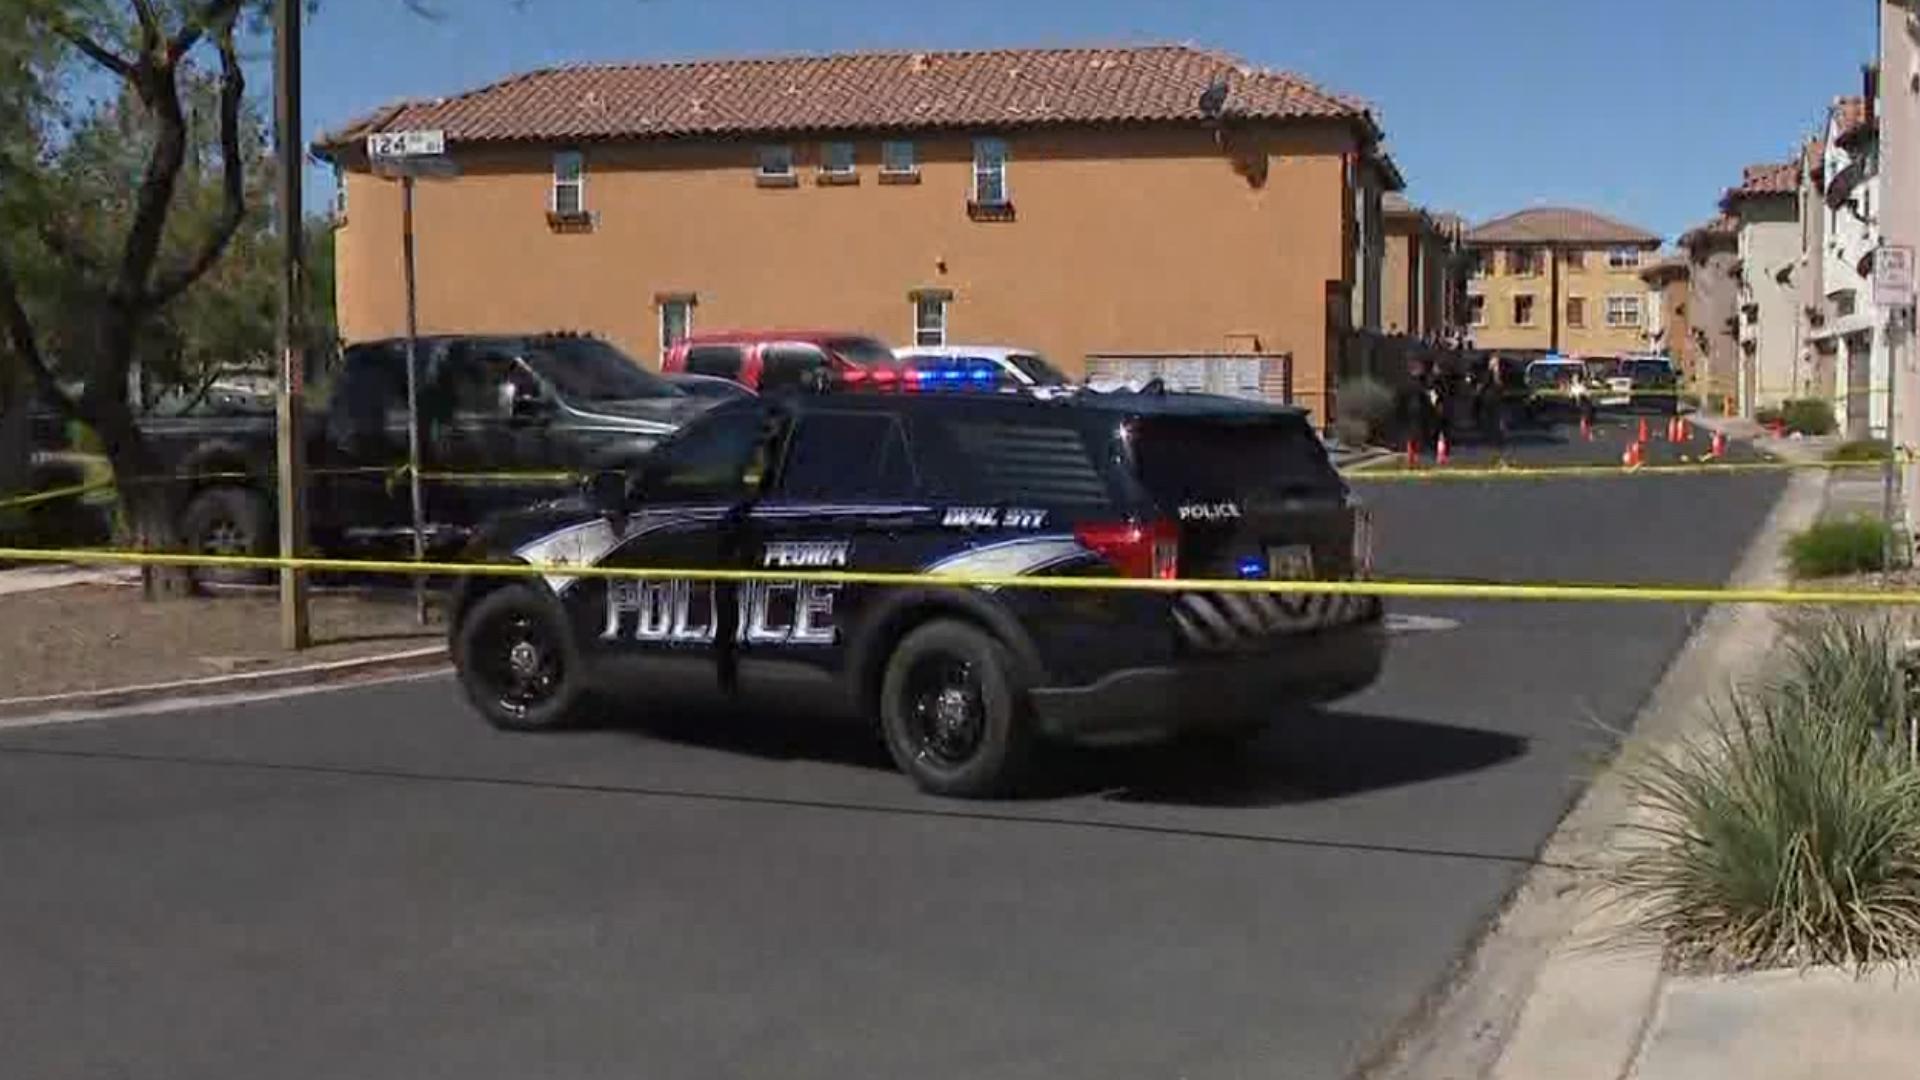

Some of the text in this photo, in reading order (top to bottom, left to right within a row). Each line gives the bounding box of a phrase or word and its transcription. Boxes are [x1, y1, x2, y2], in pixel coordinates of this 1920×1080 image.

[371, 135, 406, 155] 124
[1178, 503, 1240, 521] POLICE
[763, 541, 849, 566] PEORIA
[600, 577, 843, 643] POLICE
